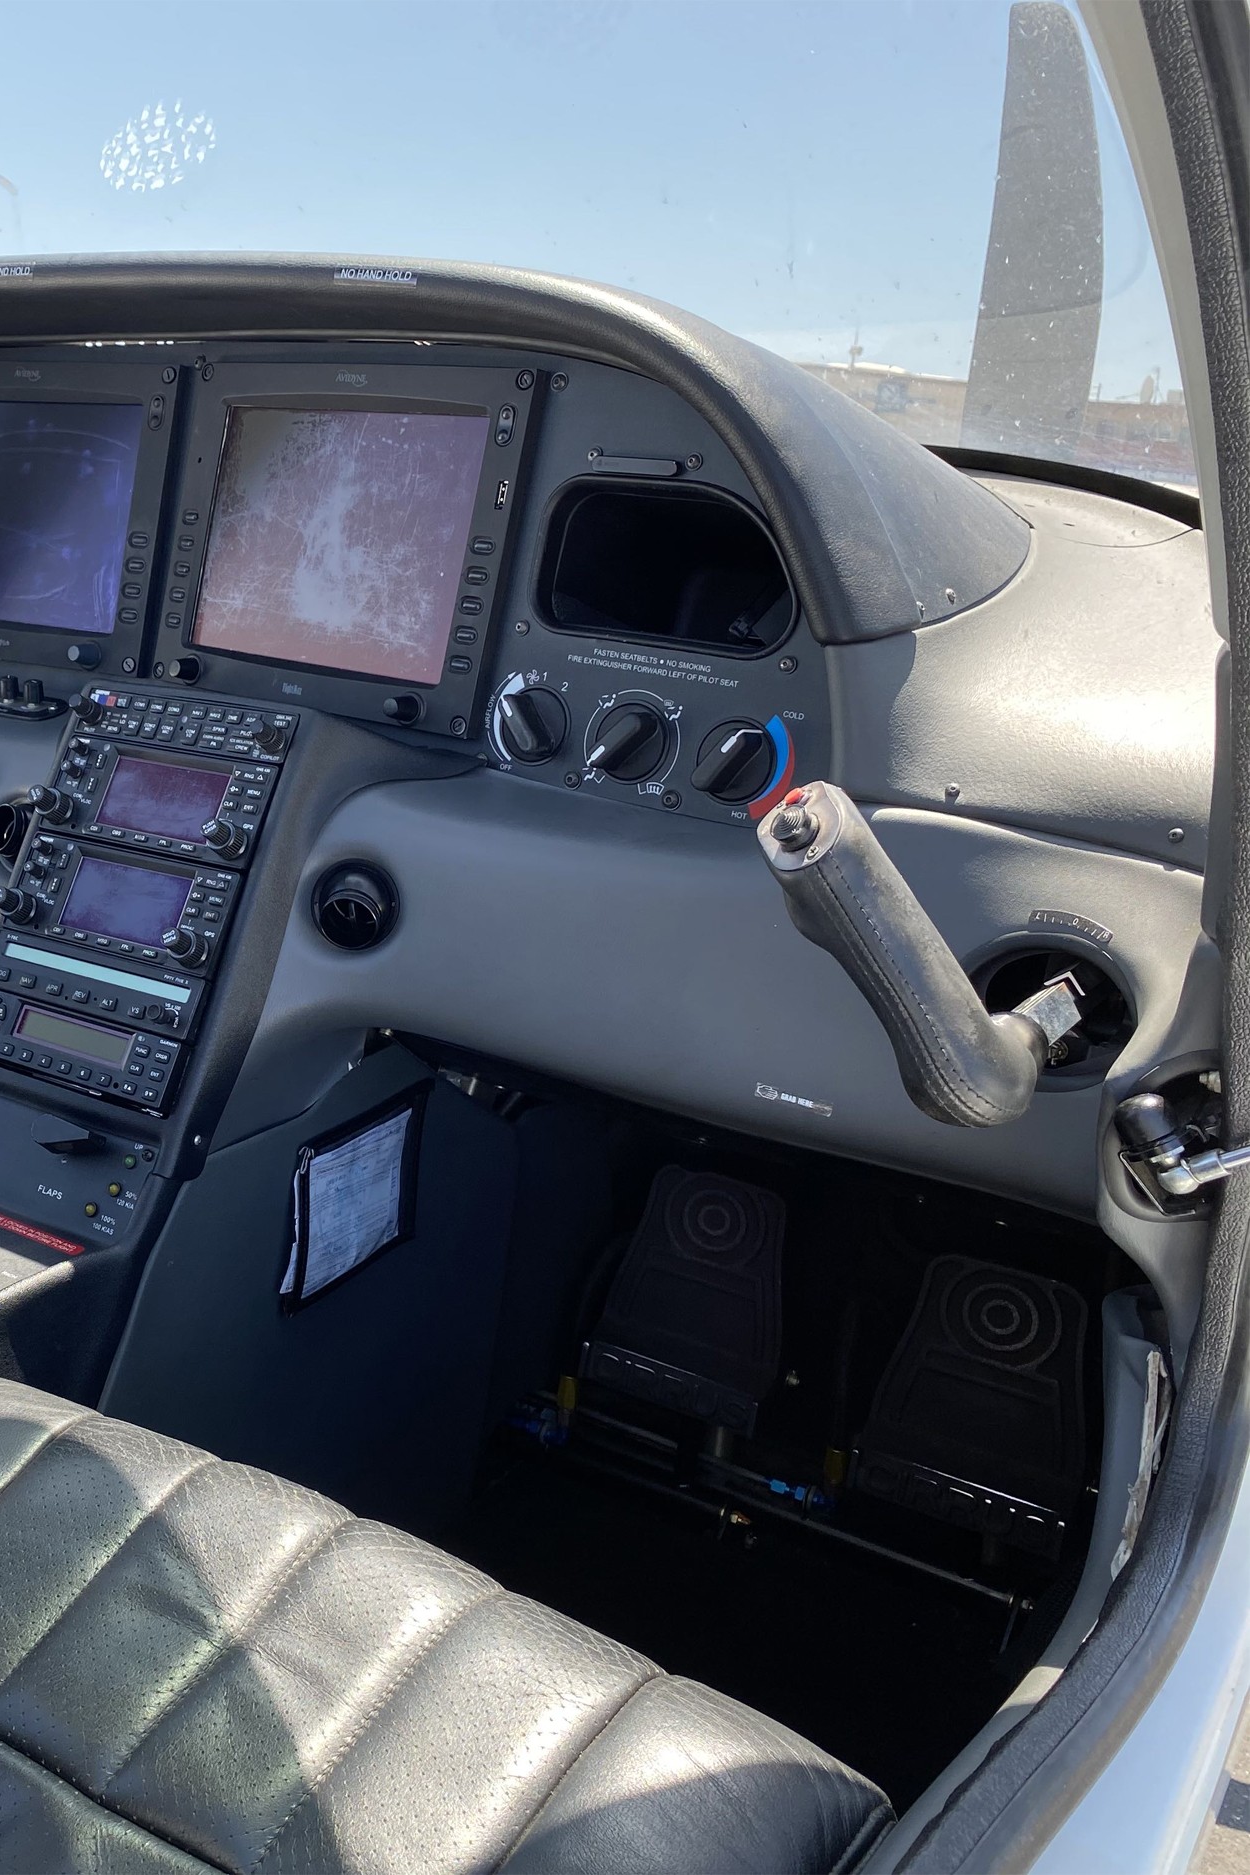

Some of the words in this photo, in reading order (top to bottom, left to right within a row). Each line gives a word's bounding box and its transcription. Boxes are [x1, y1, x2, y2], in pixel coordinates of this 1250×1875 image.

[10, 266, 30, 276] HOLD
[340, 268, 356, 278] NO
[356, 270, 383, 280] HAND
[384, 270, 412, 280] HOLD
[594, 648, 620, 658] FASTEN
[620, 652, 658, 664] SEATBELTS
[678, 661, 711, 672] SMOKING
[568, 654, 582, 663] FIRE
[584, 657, 632, 670] EXTINGUISHER
[633, 664, 668, 676] FORWARD
[668, 670, 686, 679] LEFT
[698, 675, 719, 684] PILOT
[720, 678, 738, 688] SEAT
[542, 672, 548, 681] 1
[561, 682, 568, 692] 2
[484, 694, 496, 728] AIRFLOW
[783, 710, 804, 720] COLD
[500, 764, 513, 772] OFF
[731, 810, 748, 820] HOT
[1036, 912, 1040, 920] L
[204, 930, 215, 938] GPS
[21, 976, 32, 984] NAV
[47, 984, 58, 992] APR
[75, 990, 86, 998] REV
[132, 1006, 140, 1014] VS
[160, 1039, 178, 1048] GARMIN
[136, 1046, 148, 1054] FUNC
[156, 1052, 168, 1060] CRSR
[130, 1064, 140, 1072] CLR
[780, 1092, 796, 1104] GRAB
[798, 1097, 814, 1108] HERE
[38, 1184, 63, 1200] FLAPS
[125, 1190, 138, 1201] 50%
[125, 1201, 134, 1210] KIA
[100, 1214, 116, 1226] 100%
[92, 1222, 102, 1231] 100
[102, 1225, 114, 1236] KIAS
[596, 1352, 748, 1430] CIRRUS
[863, 1463, 1053, 1553] CIRRUS
